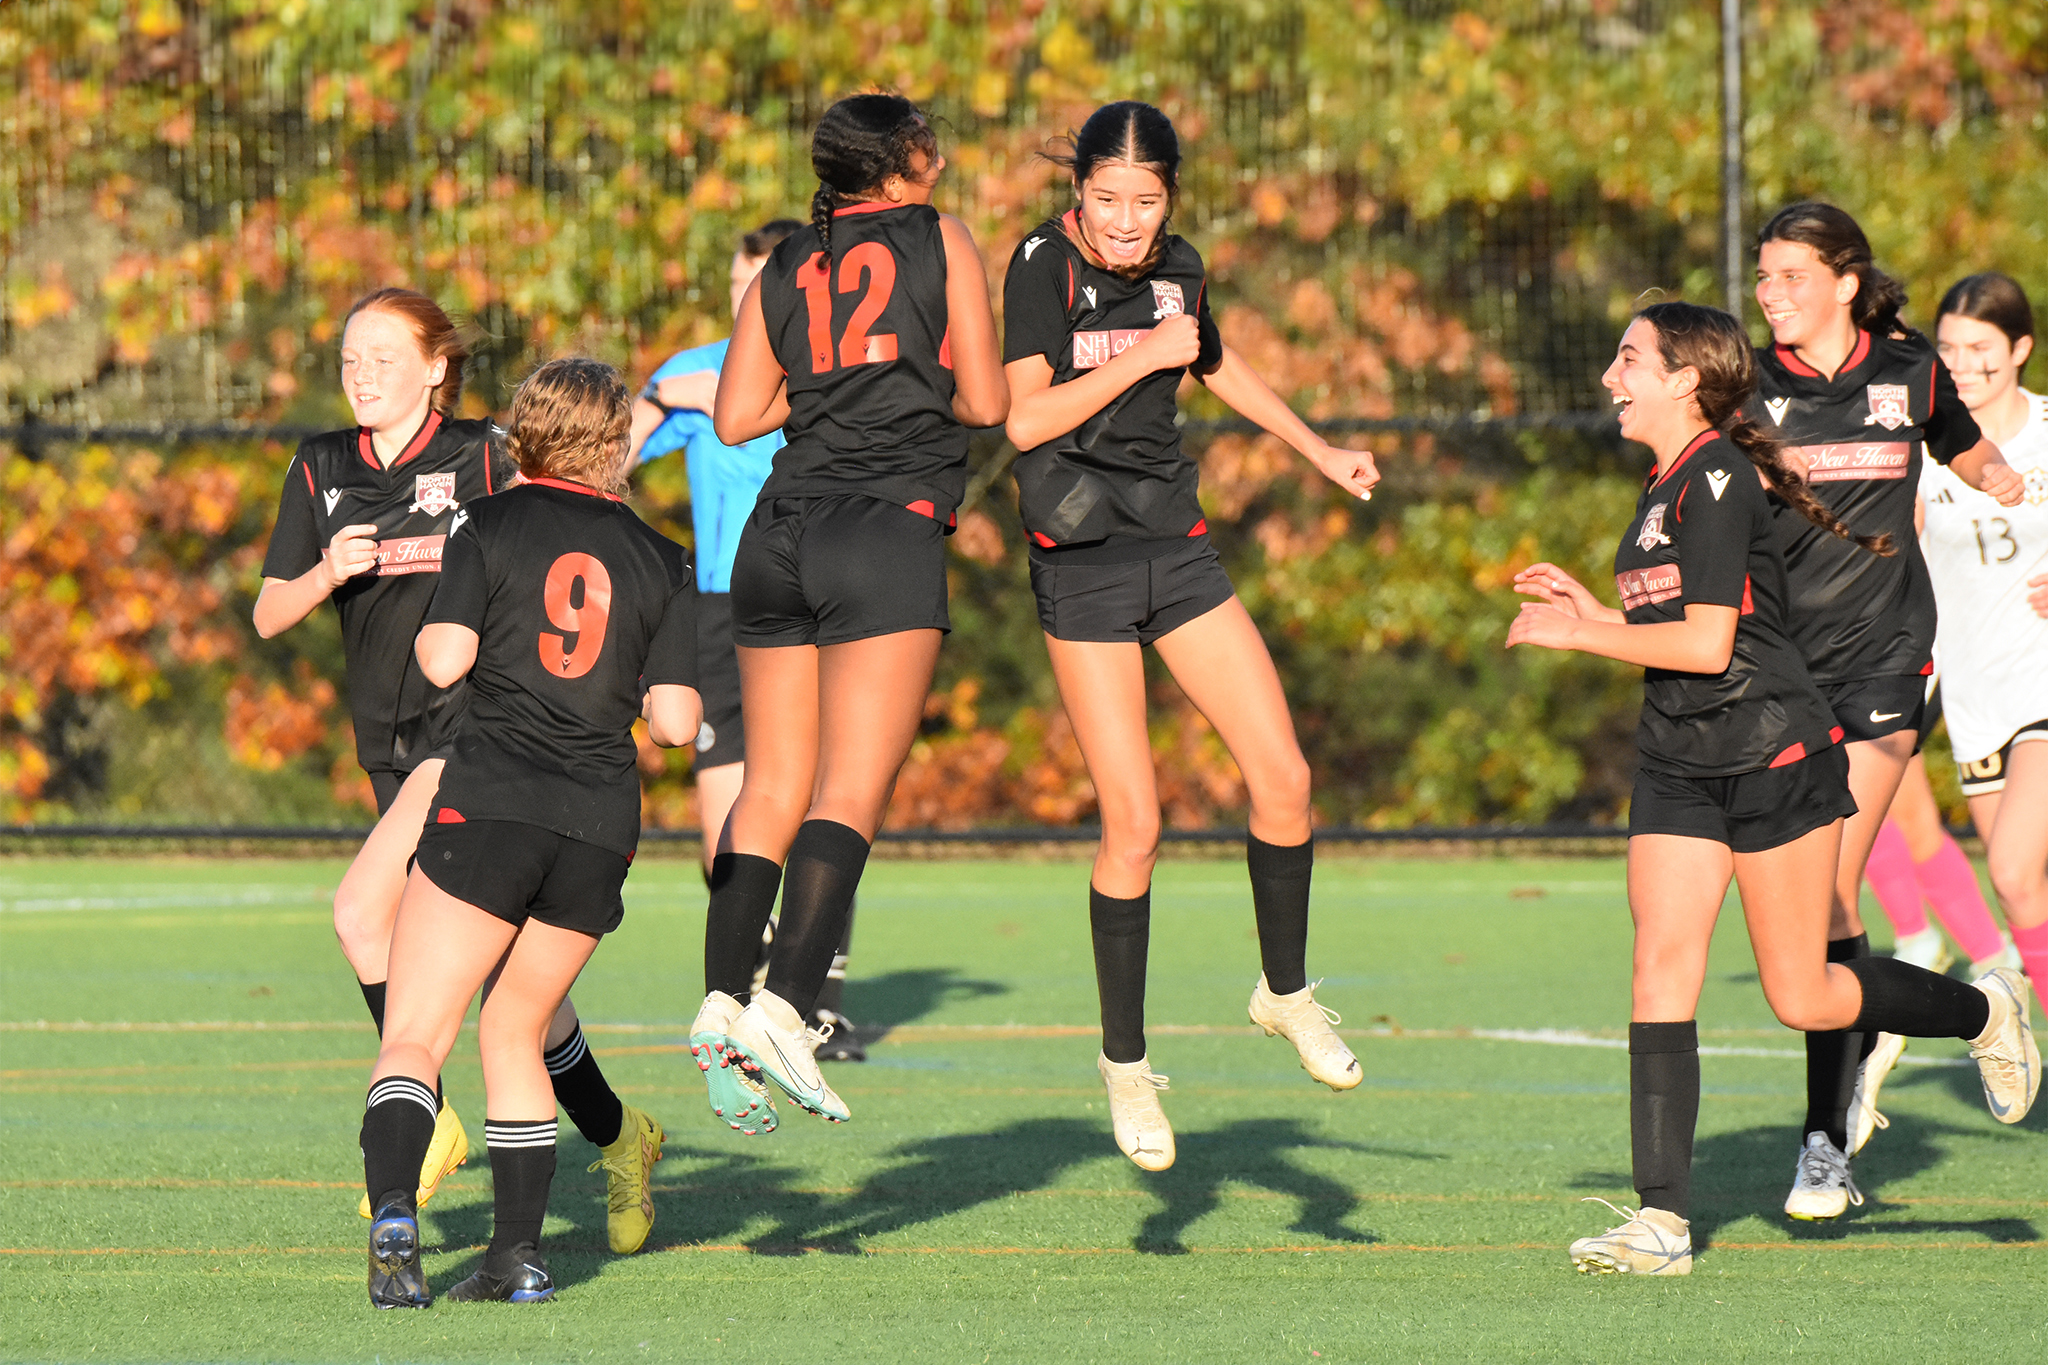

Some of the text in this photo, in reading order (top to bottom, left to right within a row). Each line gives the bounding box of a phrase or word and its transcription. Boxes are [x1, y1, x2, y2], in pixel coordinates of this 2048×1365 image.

[796, 241, 898, 374] 12
[1809, 445, 1905, 469] New Haven
[420, 475, 452, 483] NORTH
[420, 481, 452, 489] HAVEN
[1972, 517, 2020, 565] 13
[538, 551, 612, 679] 9
